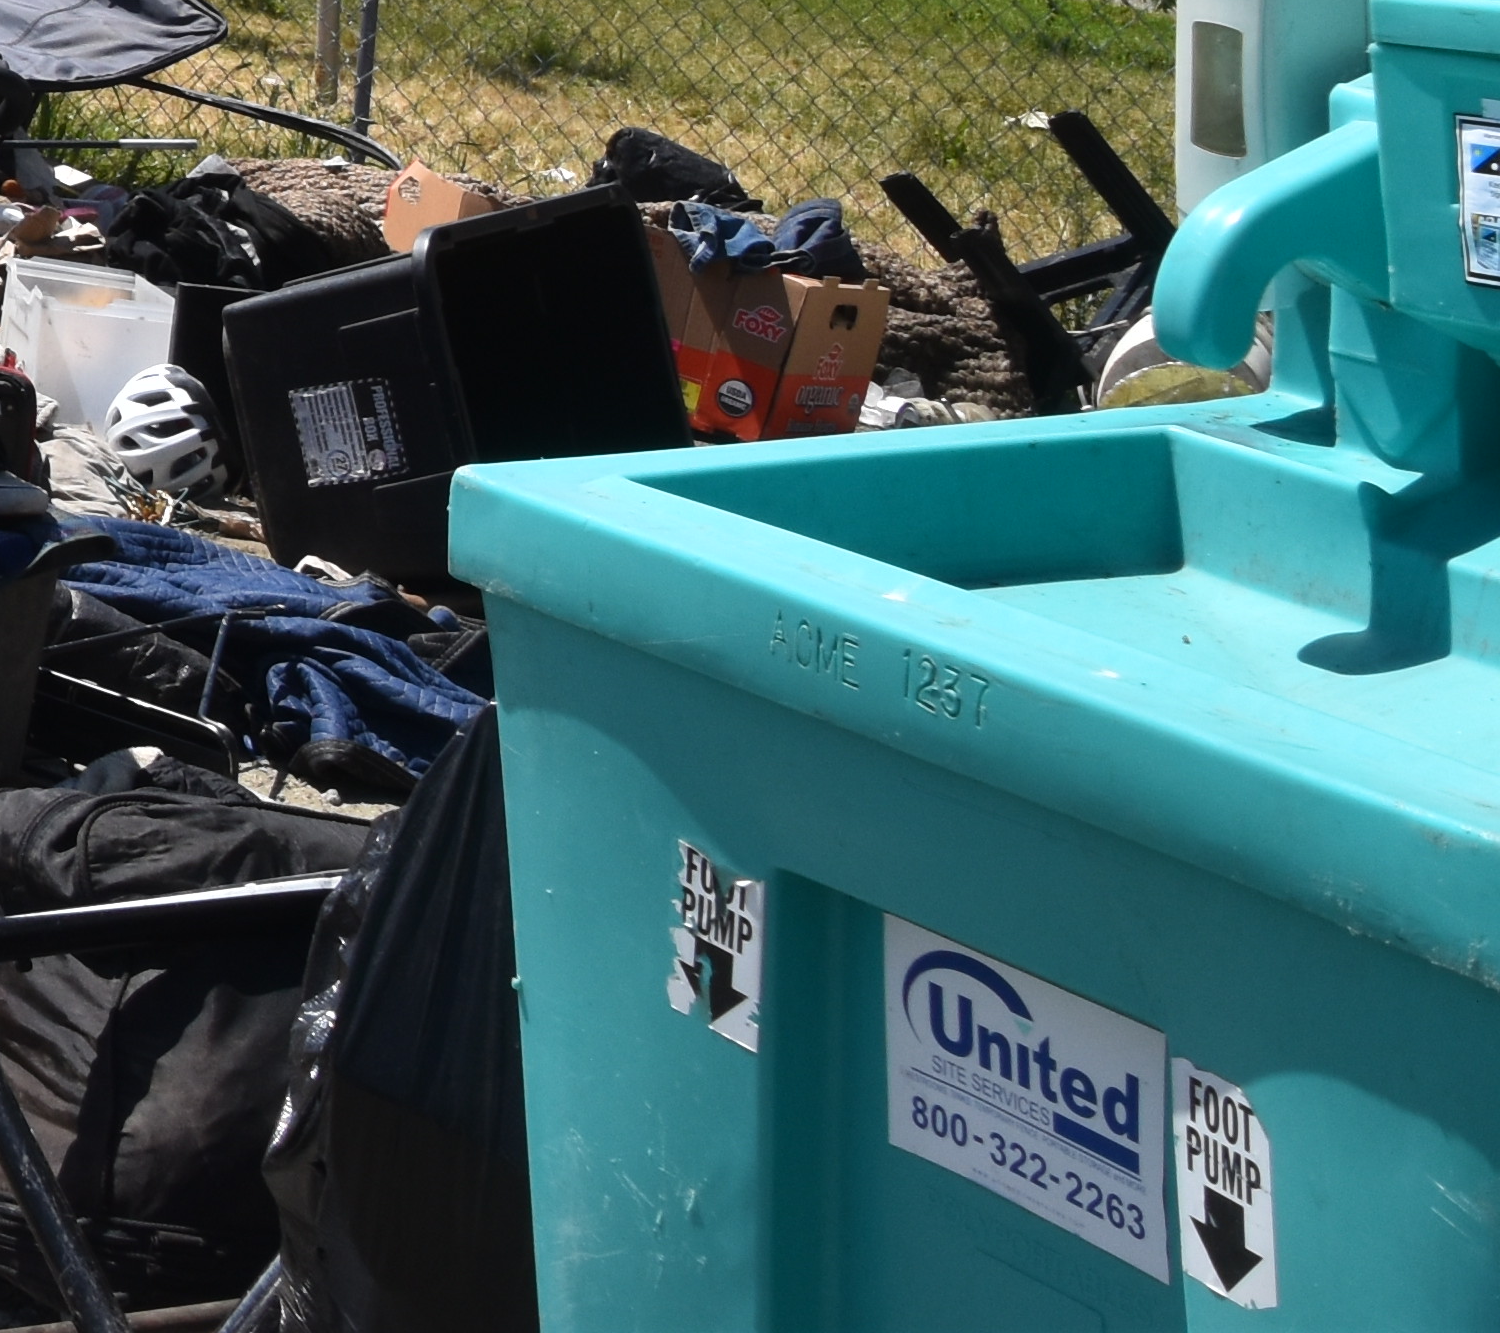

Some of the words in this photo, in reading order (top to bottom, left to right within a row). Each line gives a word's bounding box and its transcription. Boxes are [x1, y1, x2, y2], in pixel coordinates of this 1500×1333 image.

[732, 308, 786, 343] FOXY
[371, 385, 400, 468] PROFESSIONAL
[726, 385, 747, 400] USDA
[795, 385, 845, 414] organic
[335, 456, 349, 471] 27
[362, 417, 379, 442] BOX
[769, 609, 861, 691] ACME
[902, 648, 989, 729] 1237
[682, 887, 753, 954] PUMP
[928, 980, 1140, 1144] United
[931, 1055, 969, 1087] SITE
[970, 1073, 1051, 1127] SERVICES
[1189, 1075, 1255, 1153] FOOT
[911, 1095, 1146, 1240] 800-322-2263
[1186, 1124, 1261, 1206] PUMP
